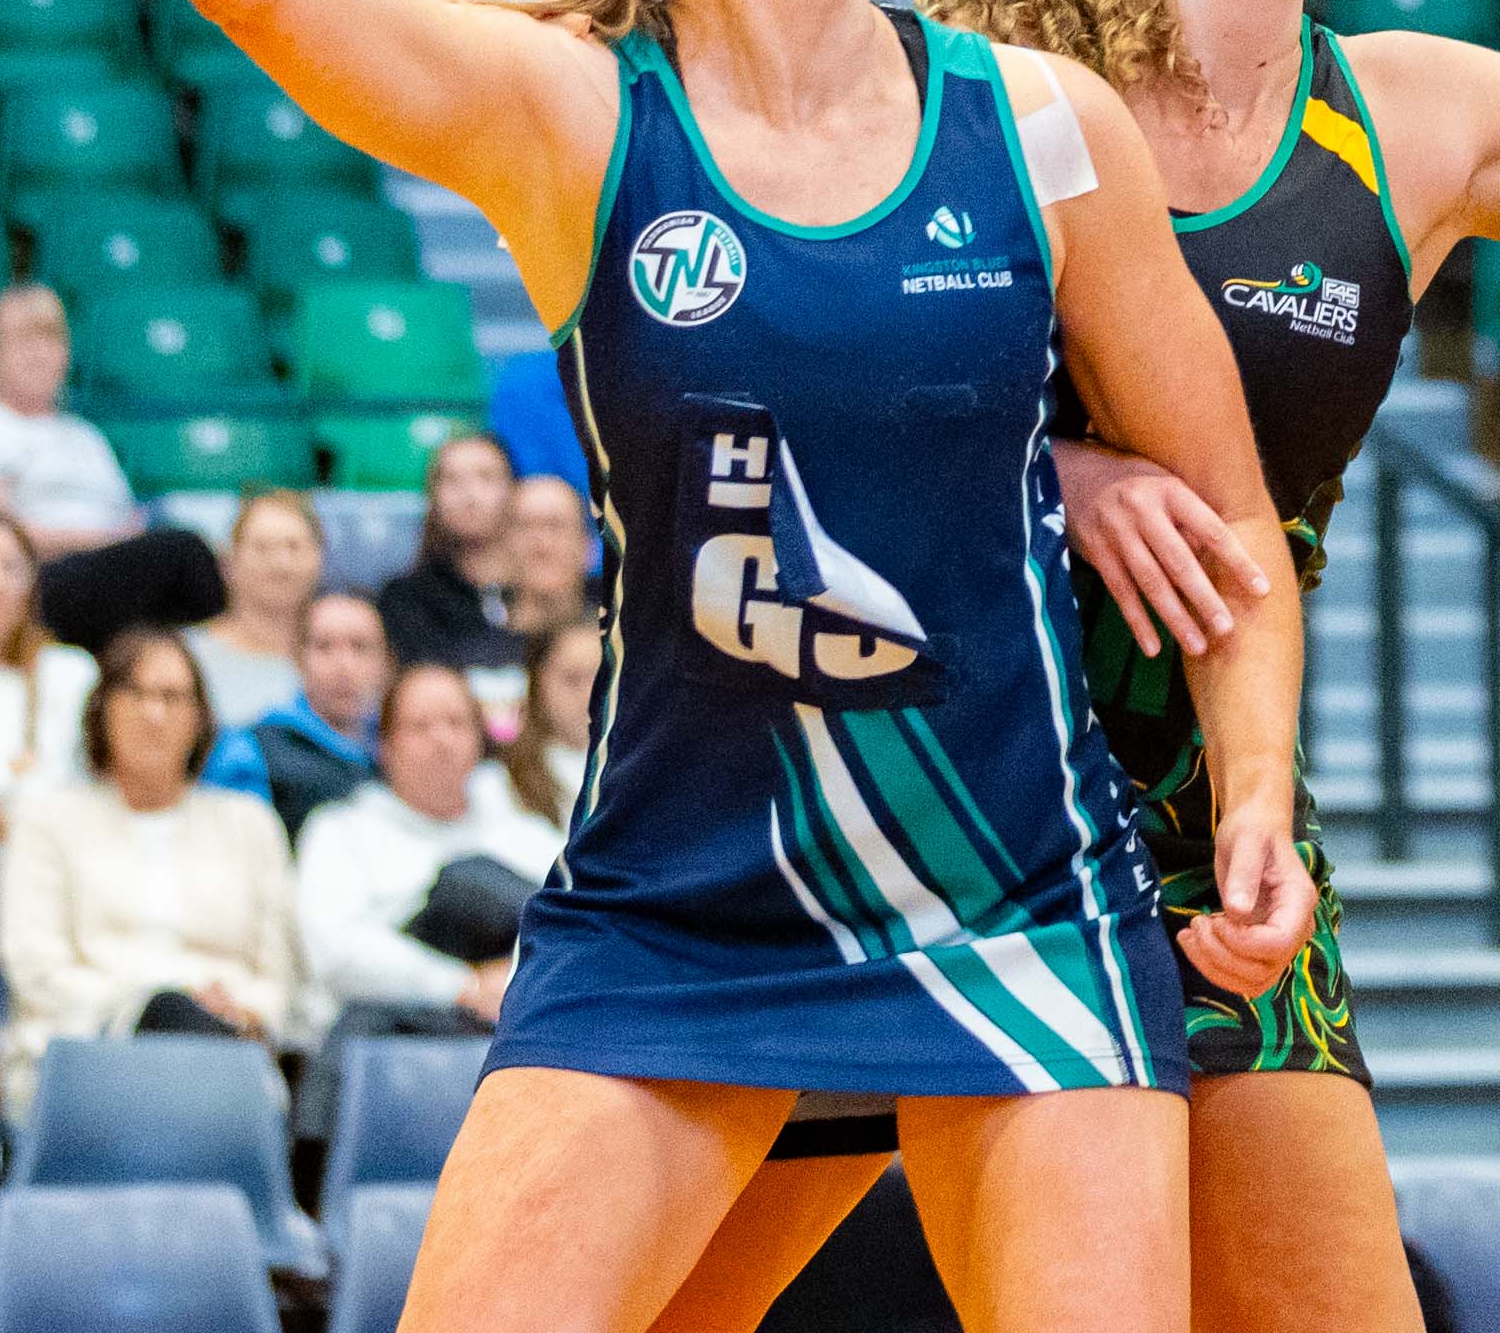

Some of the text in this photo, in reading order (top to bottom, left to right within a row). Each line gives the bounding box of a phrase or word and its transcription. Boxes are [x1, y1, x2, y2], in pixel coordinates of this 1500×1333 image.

[902, 270, 1013, 294] NETBALL CLUB
[1223, 284, 1359, 333] CAVALIERS
[1332, 330, 1356, 346] Club
